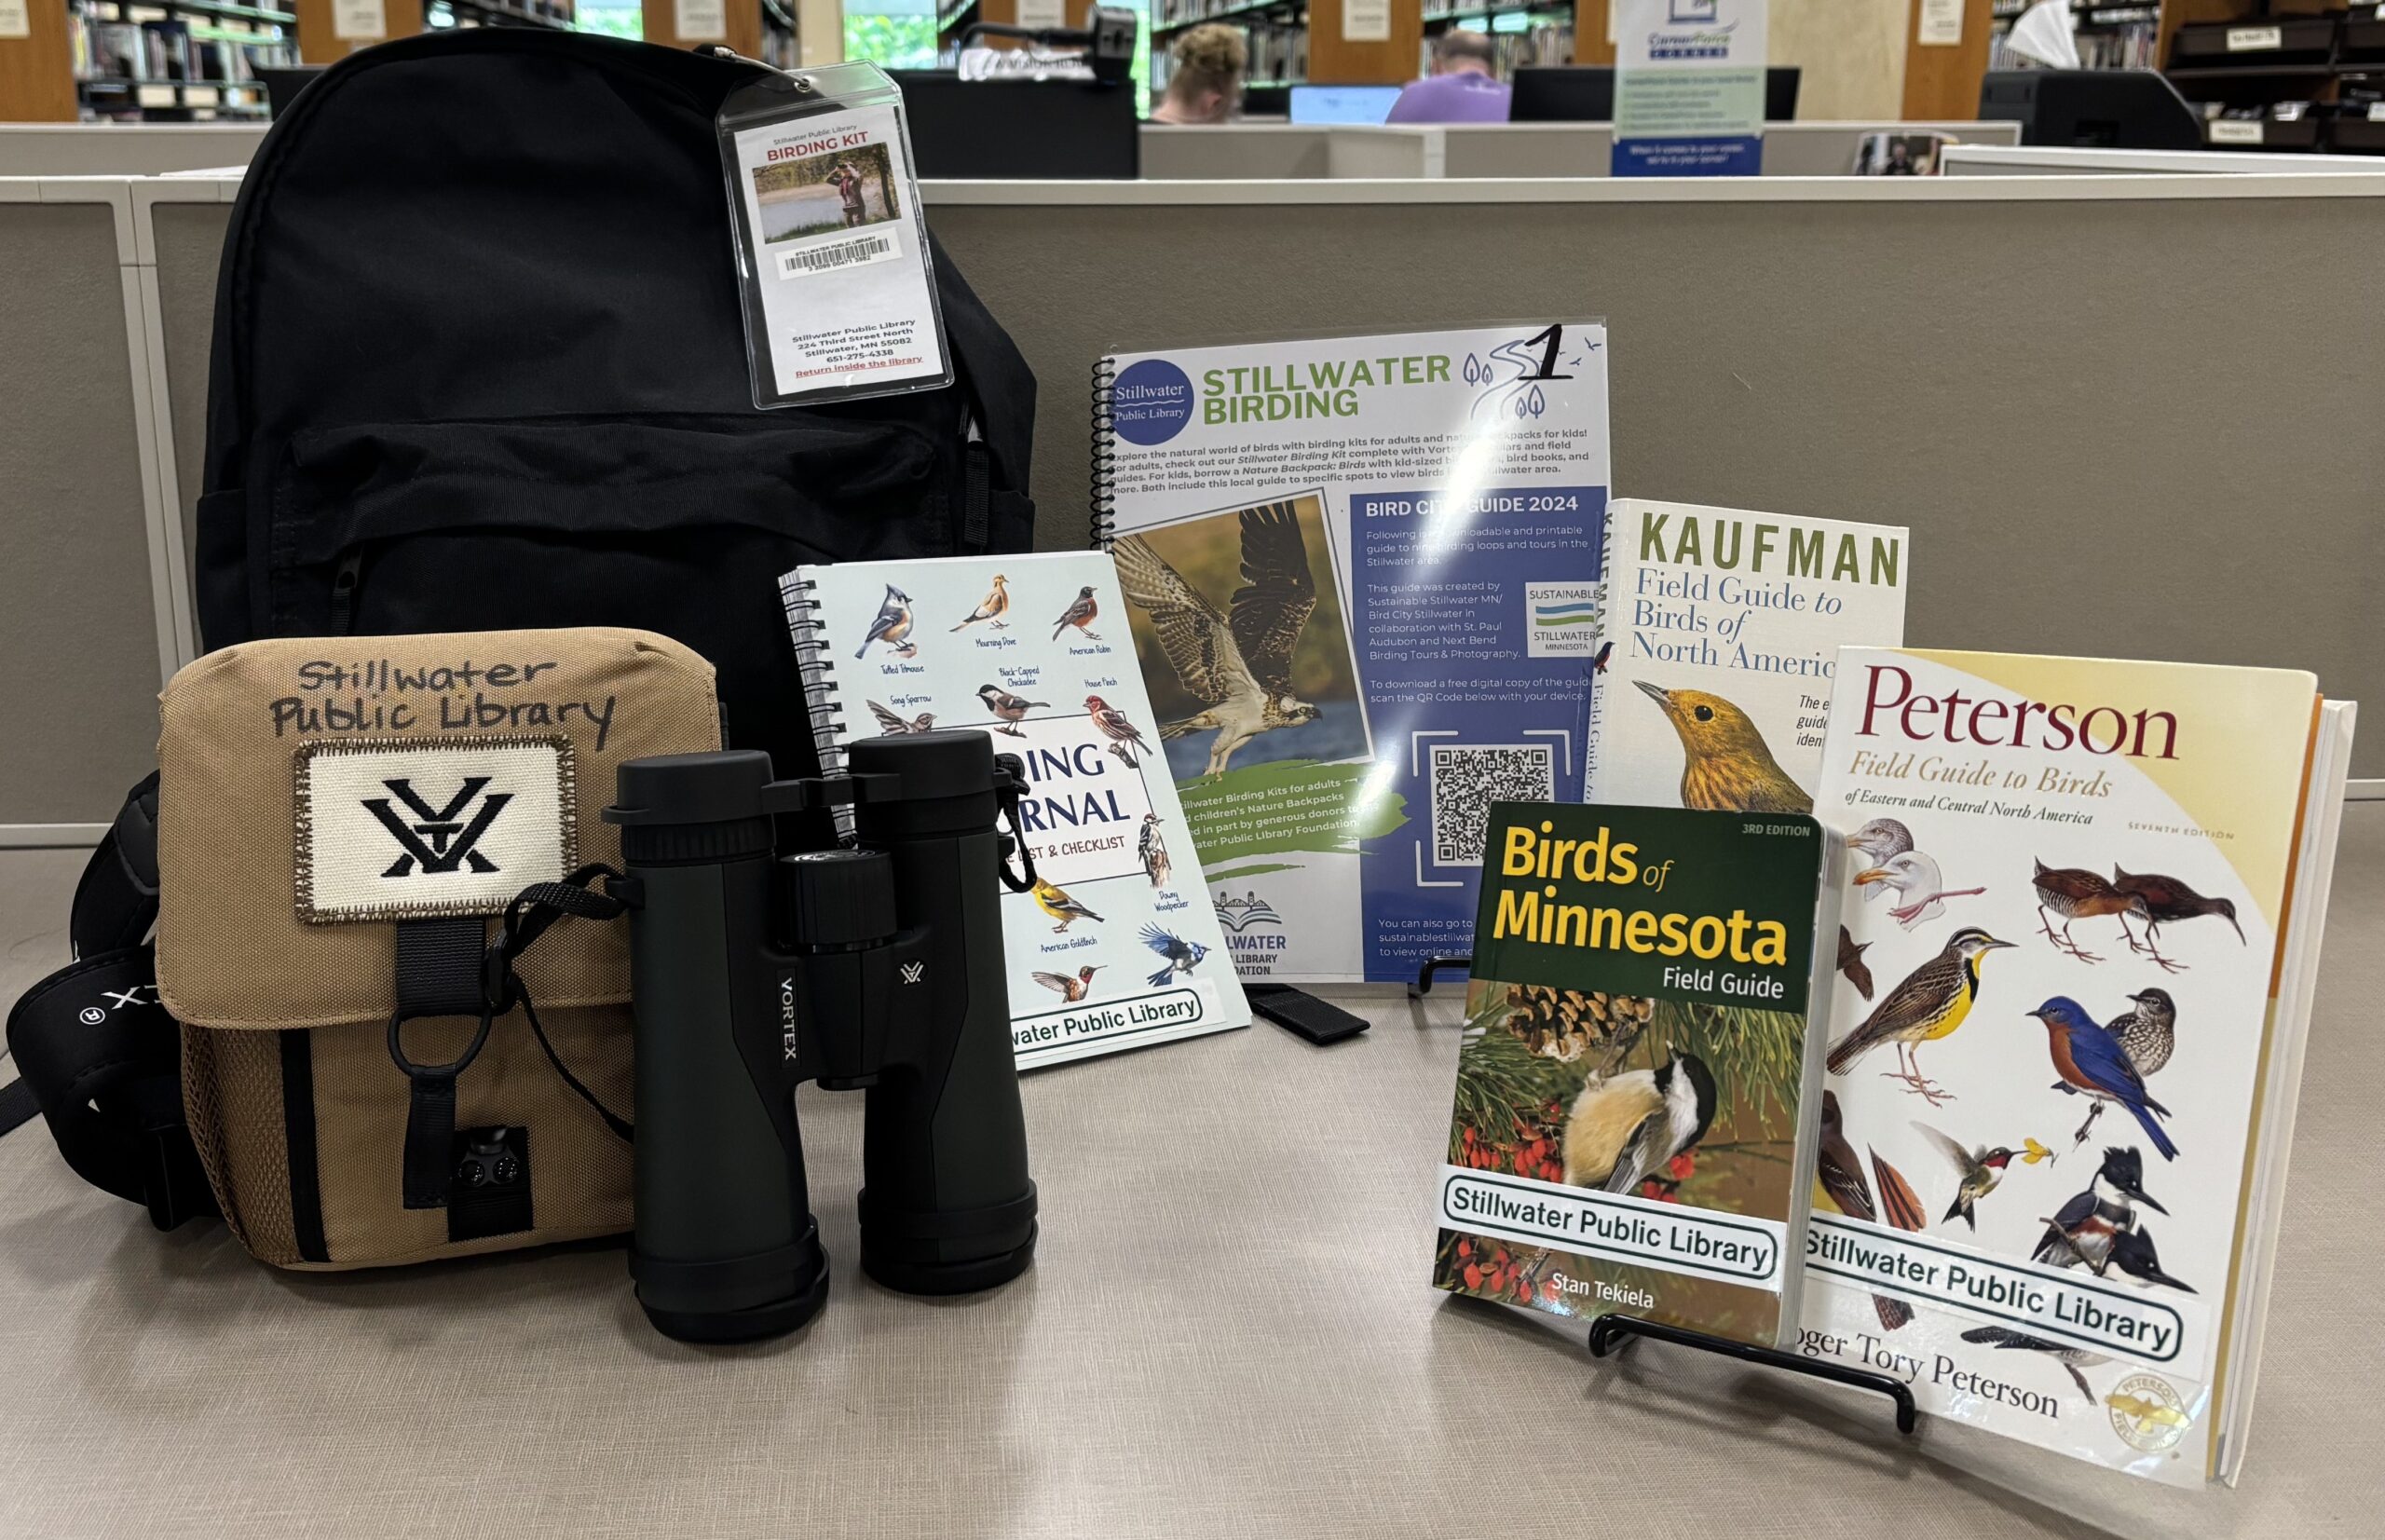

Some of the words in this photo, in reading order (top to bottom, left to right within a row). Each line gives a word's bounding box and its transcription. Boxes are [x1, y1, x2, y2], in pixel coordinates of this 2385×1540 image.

[773, 133, 807, 145] Stillwater
[809, 129, 829, 138] Public
[832, 125, 857, 134] Library
[767, 138, 838, 161] BIRDING
[842, 131, 868, 147] KIT
[796, 246, 829, 257] STILLWATER
[852, 236, 876, 245] LIBRARY
[792, 331, 842, 343] Stillwater
[844, 326, 877, 335] Public
[879, 320, 915, 330] Library
[797, 342, 817, 350] 224
[819, 337, 846, 347] Third
[849, 333, 880, 343] Street
[883, 328, 913, 337] North
[805, 346, 858, 358] Stillwater,
[880, 337, 913, 347] 55082
[826, 349, 894, 363] 651-275-4338
[1518, 323, 1574, 380] 1
[796, 367, 831, 378] Return
[835, 362, 865, 372] inside
[1203, 355, 1451, 397] STILLWATER
[1116, 384, 1184, 401] Stillwater
[1115, 409, 1147, 421] Public
[1150, 407, 1185, 420] Library
[1204, 389, 1358, 425] BIRDING
[1366, 501, 1411, 517] BIRD
[1416, 499, 1447, 515] CIT
[1467, 497, 1524, 513] GUIDE
[1529, 496, 1579, 511] 2024
[1640, 512, 1899, 588] KAUFMAN
[1368, 583, 1388, 593] This
[1390, 583, 1420, 595] guide
[1423, 583, 1443, 593] was
[1444, 582, 1485, 592] created
[1487, 581, 1500, 593] by
[1530, 590, 1600, 600] SUSTAINABLE
[1635, 566, 1710, 602] Field
[1719, 576, 1806, 611] Guide
[1815, 593, 1843, 615] to
[1368, 596, 1427, 607] Sustainable
[1430, 594, 1478, 606] Stillwater
[1481, 593, 1503, 605] MN/
[1369, 609, 1390, 620] Bird
[1392, 609, 1412, 621] City
[1414, 608, 1463, 619] Stillwater
[1465, 608, 1475, 618] in
[1632, 600, 1709, 634] Birds
[1717, 609, 1751, 645] of
[1369, 622, 1437, 634] collaboration
[1439, 622, 1461, 632] with
[1464, 622, 1478, 632] St.
[1479, 621, 1502, 632] Paul
[1533, 632, 1597, 641] STILLWATER
[975, 637, 1002, 649] Mourning
[1002, 636, 1017, 647] Dove
[1070, 647, 1096, 656] American
[1096, 645, 1111, 654] Robin
[1370, 636, 1416, 647] Audubon
[1420, 636, 1440, 646] and
[1442, 635, 1466, 646] Next
[1469, 635, 1496, 645] Bend
[1370, 650, 1407, 662] Birding
[1411, 650, 1438, 660] Tours
[1440, 650, 1448, 659] &
[1451, 648, 1520, 661] Photography.
[1630, 632, 1719, 667] North
[1729, 642, 1835, 679] Americ
[299, 660, 558, 692] Stillwater
[999, 665, 1040, 678] Black-Capped
[1084, 678, 1101, 688] House
[1103, 676, 1118, 686] Finch
[1008, 678, 1036, 688] Chickadee
[891, 695, 906, 708] Song
[906, 693, 932, 706] Sparrow
[1591, 684, 1604, 725] Field
[1800, 695, 1820, 710] The
[1854, 664, 2180, 761] Peterson
[269, 697, 419, 736] Public
[441, 696, 616, 752] Library
[1588, 730, 1601, 779] Guide
[1848, 750, 1915, 779] Field
[1919, 756, 1997, 788] Guide
[2002, 770, 2027, 790] to
[2036, 766, 2113, 799] Birds
[1226, 791, 1265, 805] Birding
[1267, 784, 1288, 797] Kits
[1289, 783, 1305, 794] for
[1307, 779, 1341, 792] adults
[1586, 784, 1593, 799] to
[1019, 789, 1131, 833] RNAL
[1193, 806, 1245, 822] children's
[1247, 801, 1284, 814] Nature
[1286, 792, 1345, 810] Backpacks
[1845, 789, 1860, 805] of
[1860, 789, 1907, 807] Eastern
[1910, 795, 1936, 811] and
[1938, 797, 1988, 815] Central
[1990, 801, 2032, 820] North
[2034, 807, 2093, 825] America
[1204, 824, 1214, 835] in
[1217, 820, 1237, 834] part
[1240, 816, 1254, 829] by
[1256, 813, 1306, 829] generous
[1308, 807, 1345, 819] donors
[1742, 824, 1765, 835] 3RD
[1766, 824, 1811, 838] EDITION
[2128, 821, 2179, 834] SEVENTH
[2184, 827, 2234, 840] EDITION
[1049, 844, 1058, 857] &
[1062, 836, 1125, 855] CHECKLIST
[1220, 835, 1254, 848] Public
[1256, 829, 1293, 844] Library
[1502, 820, 1639, 886] Birds
[1643, 860, 1675, 893] of
[1159, 891, 1179, 902] Downy
[1153, 902, 1189, 913] Woodpecker
[1492, 885, 1788, 967] Minnesota
[1041, 943, 1070, 952] American
[1226, 935, 1286, 950] LWATER
[1235, 954, 1278, 963] LIBRARY
[1234, 965, 1271, 975] DATION
[1663, 967, 1713, 991] Field
[1720, 973, 1785, 999] Guide
[780, 976, 797, 1060] VORTEX
[1011, 1021, 1060, 1047] water
[1065, 1013, 1125, 1037] Public
[1131, 998, 1196, 1024] Library
[1453, 1187, 1574, 1231] Stillwater
[1580, 1211, 1662, 1247] Public
[1670, 1226, 1768, 1271] Library
[1552, 1273, 1589, 1297] Stan
[1595, 1280, 1655, 1310] Tekiela
[1806, 1229, 1939, 1286] Stillwater
[1947, 1265, 2044, 1314] Public
[2055, 1292, 2172, 1353] Library
[1797, 1327, 1848, 1358] oger
[1856, 1333, 1926, 1384] Tory
[1932, 1355, 2059, 1419] Peterson
